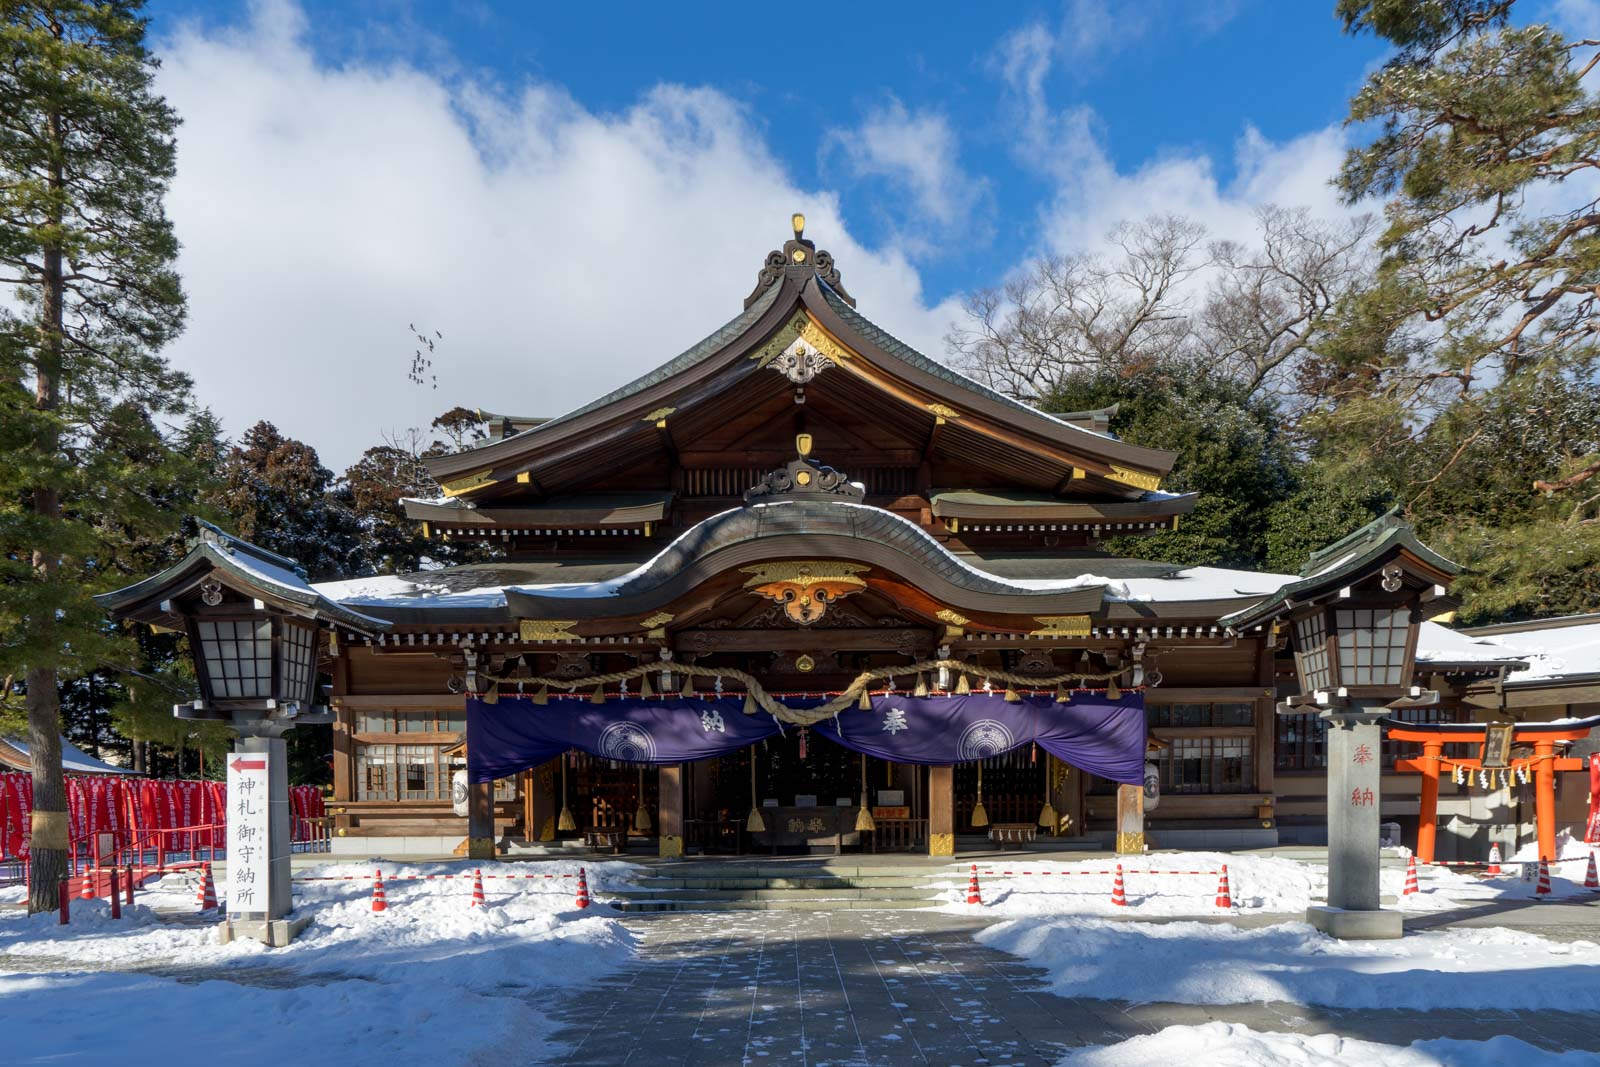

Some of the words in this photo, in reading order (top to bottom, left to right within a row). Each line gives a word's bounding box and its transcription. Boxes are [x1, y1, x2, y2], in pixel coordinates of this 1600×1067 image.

[701, 709, 725, 733] 納
[882, 708, 908, 735] 奉
[1351, 743, 1374, 807] 奉納
[236, 777, 256, 906] 神札・御守納所
